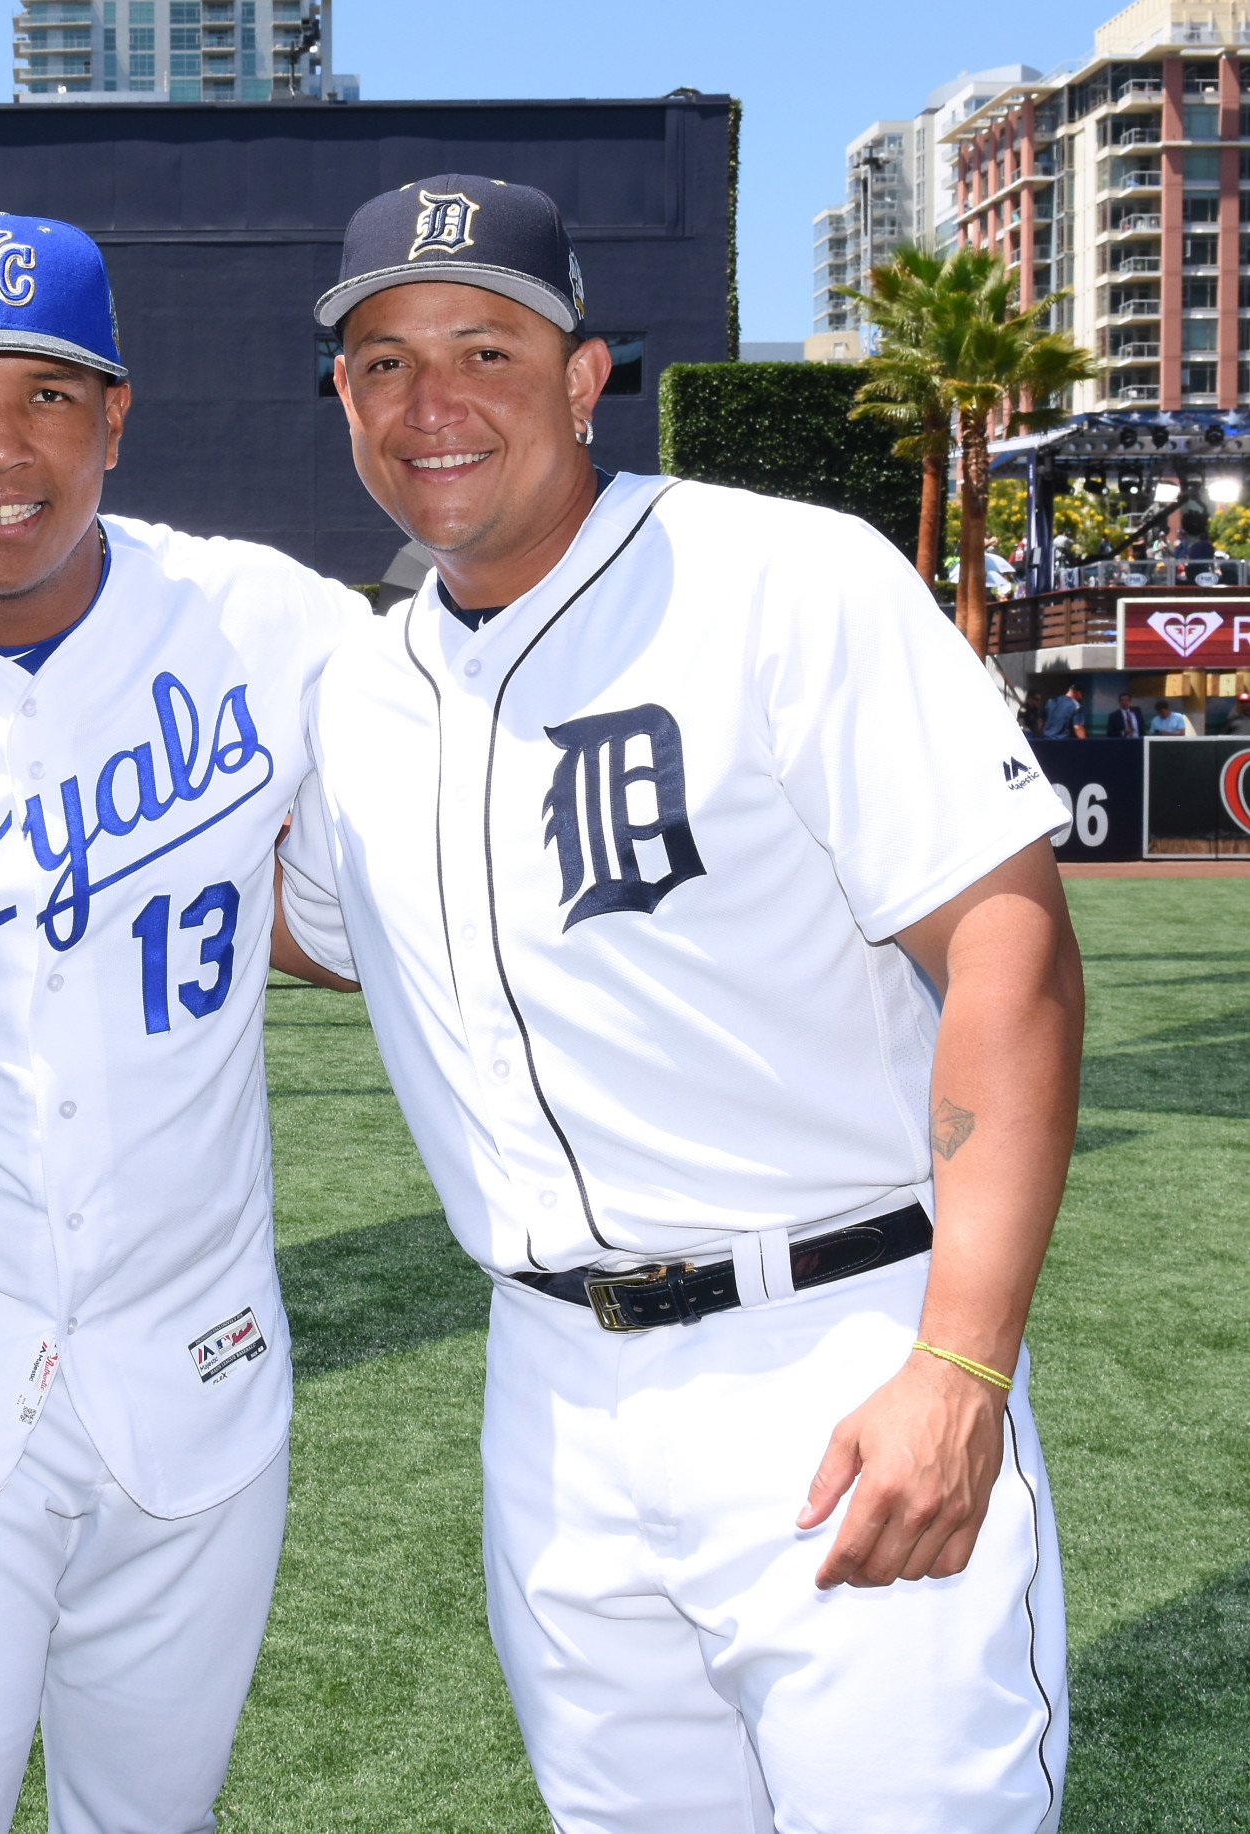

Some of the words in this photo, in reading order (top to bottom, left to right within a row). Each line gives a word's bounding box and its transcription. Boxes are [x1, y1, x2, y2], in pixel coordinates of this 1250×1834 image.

[408, 190, 480, 261] D
[541, 703, 707, 935] D
[1008, 771, 1040, 791] Majestic
[132, 880, 241, 1034] 13
